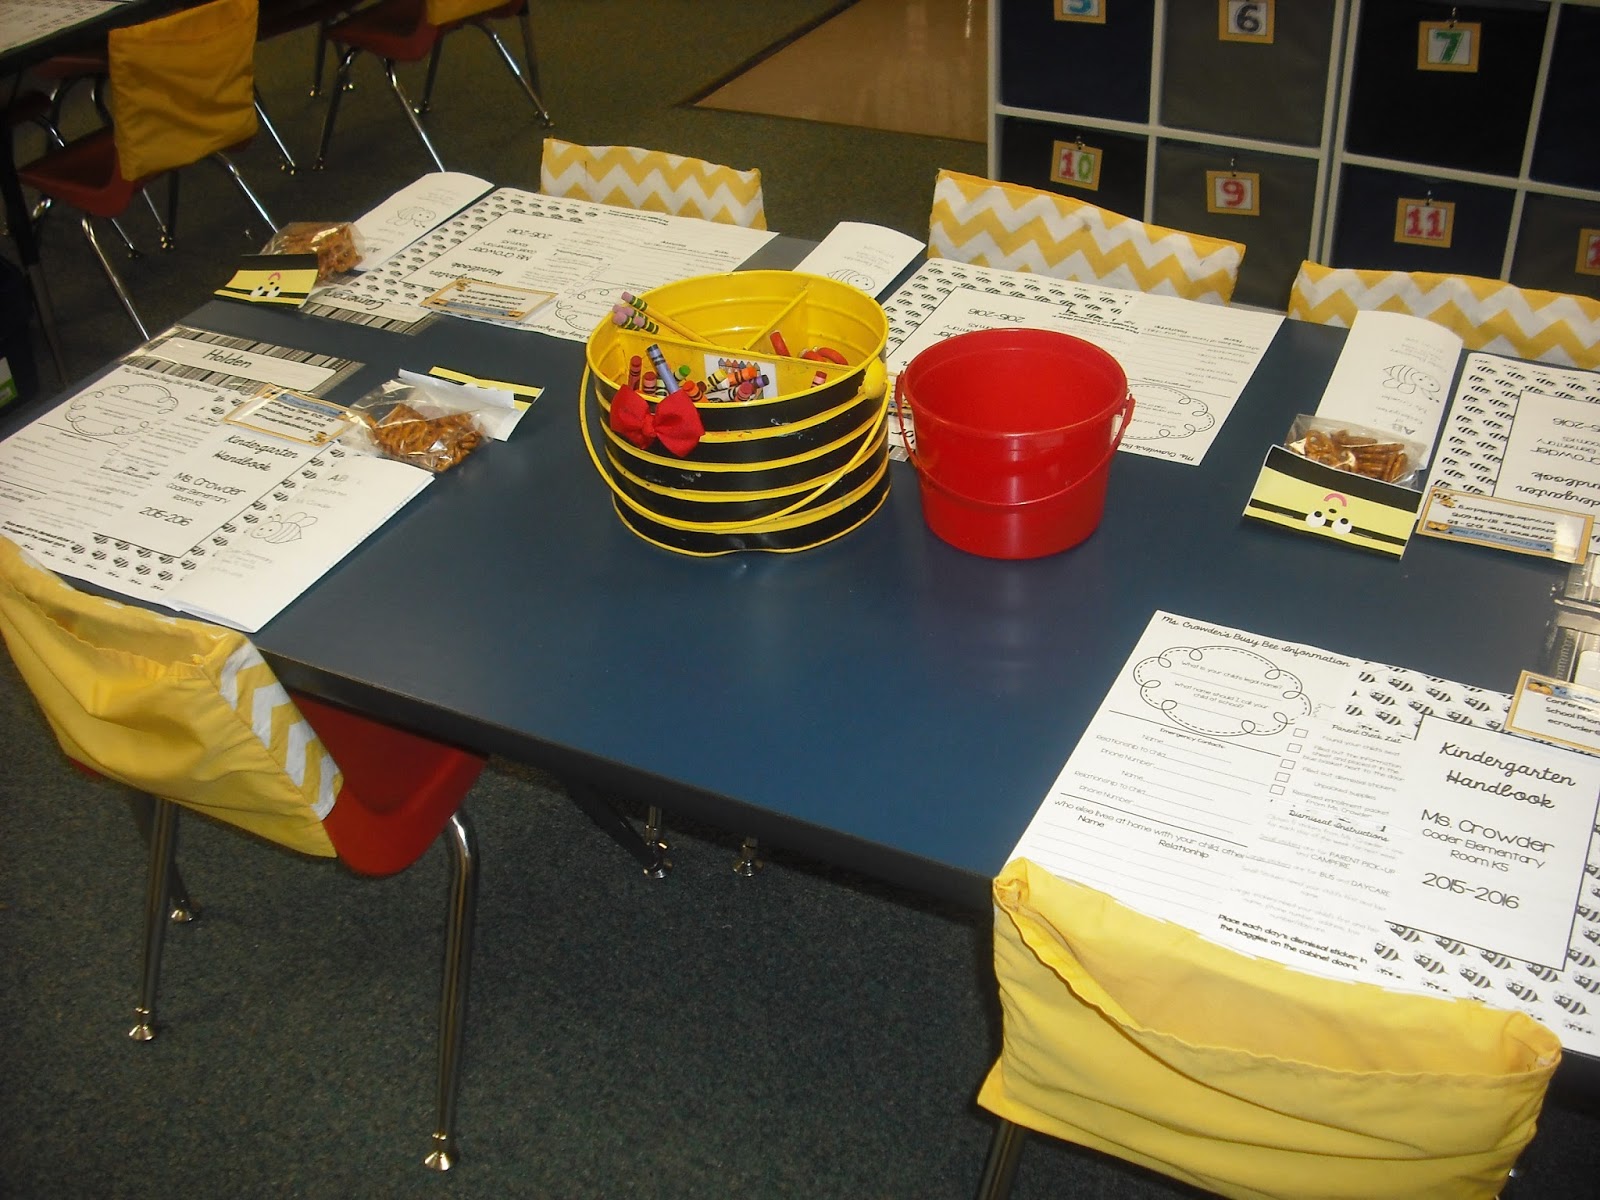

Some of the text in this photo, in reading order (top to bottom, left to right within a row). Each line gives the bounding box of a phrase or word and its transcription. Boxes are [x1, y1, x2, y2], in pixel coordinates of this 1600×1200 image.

[1236, 4, 1260, 33] 6
[1436, 31, 1463, 62] 7
[1060, 151, 1094, 180] 10
[1222, 179, 1246, 208] 9
[1407, 207, 1442, 238] 11
[324, 290, 385, 311] Cameron
[202, 349, 253, 369] Holden
[212, 450, 271, 472] Handbook
[225, 434, 299, 459] Kindergarten
[193, 477, 246, 496] Crowder
[1182, 621, 1232, 639] Crowder's
[1233, 633, 1260, 648] Busy
[1261, 640, 1280, 651] Bee
[1281, 645, 1351, 668] Information
[1181, 660, 1199, 669] What
[1261, 681, 1283, 690] name?
[1174, 681, 1192, 690] What
[1193, 687, 1211, 695] name
[1212, 690, 1235, 701] should
[1241, 698, 1253, 706] call
[1252, 702, 1269, 710] your
[1545, 706, 1576, 719] School
[1096, 734, 1139, 751] Relationship
[1159, 727, 1196, 743] Emergency
[1331, 724, 1402, 744] Parent Check List
[1360, 756, 1402, 769] information
[1439, 741, 1576, 787] Kindergarten
[1074, 770, 1118, 787] Relationship
[1446, 769, 1555, 809] Handbook
[1075, 804, 1094, 815] else
[1095, 810, 1115, 821] lives
[1115, 817, 1127, 825] at
[1127, 820, 1152, 832] home
[1154, 828, 1174, 839] with
[1175, 834, 1198, 845] your
[1077, 814, 1105, 828] Name
[1289, 809, 1332, 826] Dismissal
[1333, 822, 1390, 842] Instructions
[1421, 808, 1555, 854] Ms. Crowder
[1310, 854, 1351, 870] CAMPFIRE
[1329, 851, 1396, 874] PARENT PICK-UP
[1422, 828, 1546, 869] Coder Elementary
[1450, 849, 1510, 873] Room K5
[1319, 871, 1335, 881] BUS
[1351, 880, 1392, 897] DAYCARE
[1421, 871, 1520, 910] 2015-2016
[1218, 913, 1240, 925] Place
[1242, 922, 1263, 932] each
[1264, 928, 1289, 940] day's
[1290, 935, 1329, 951] dismissal
[1329, 948, 1359, 960] sticker
[1220, 924, 1359, 971] the baggies on the cabinet doors.
